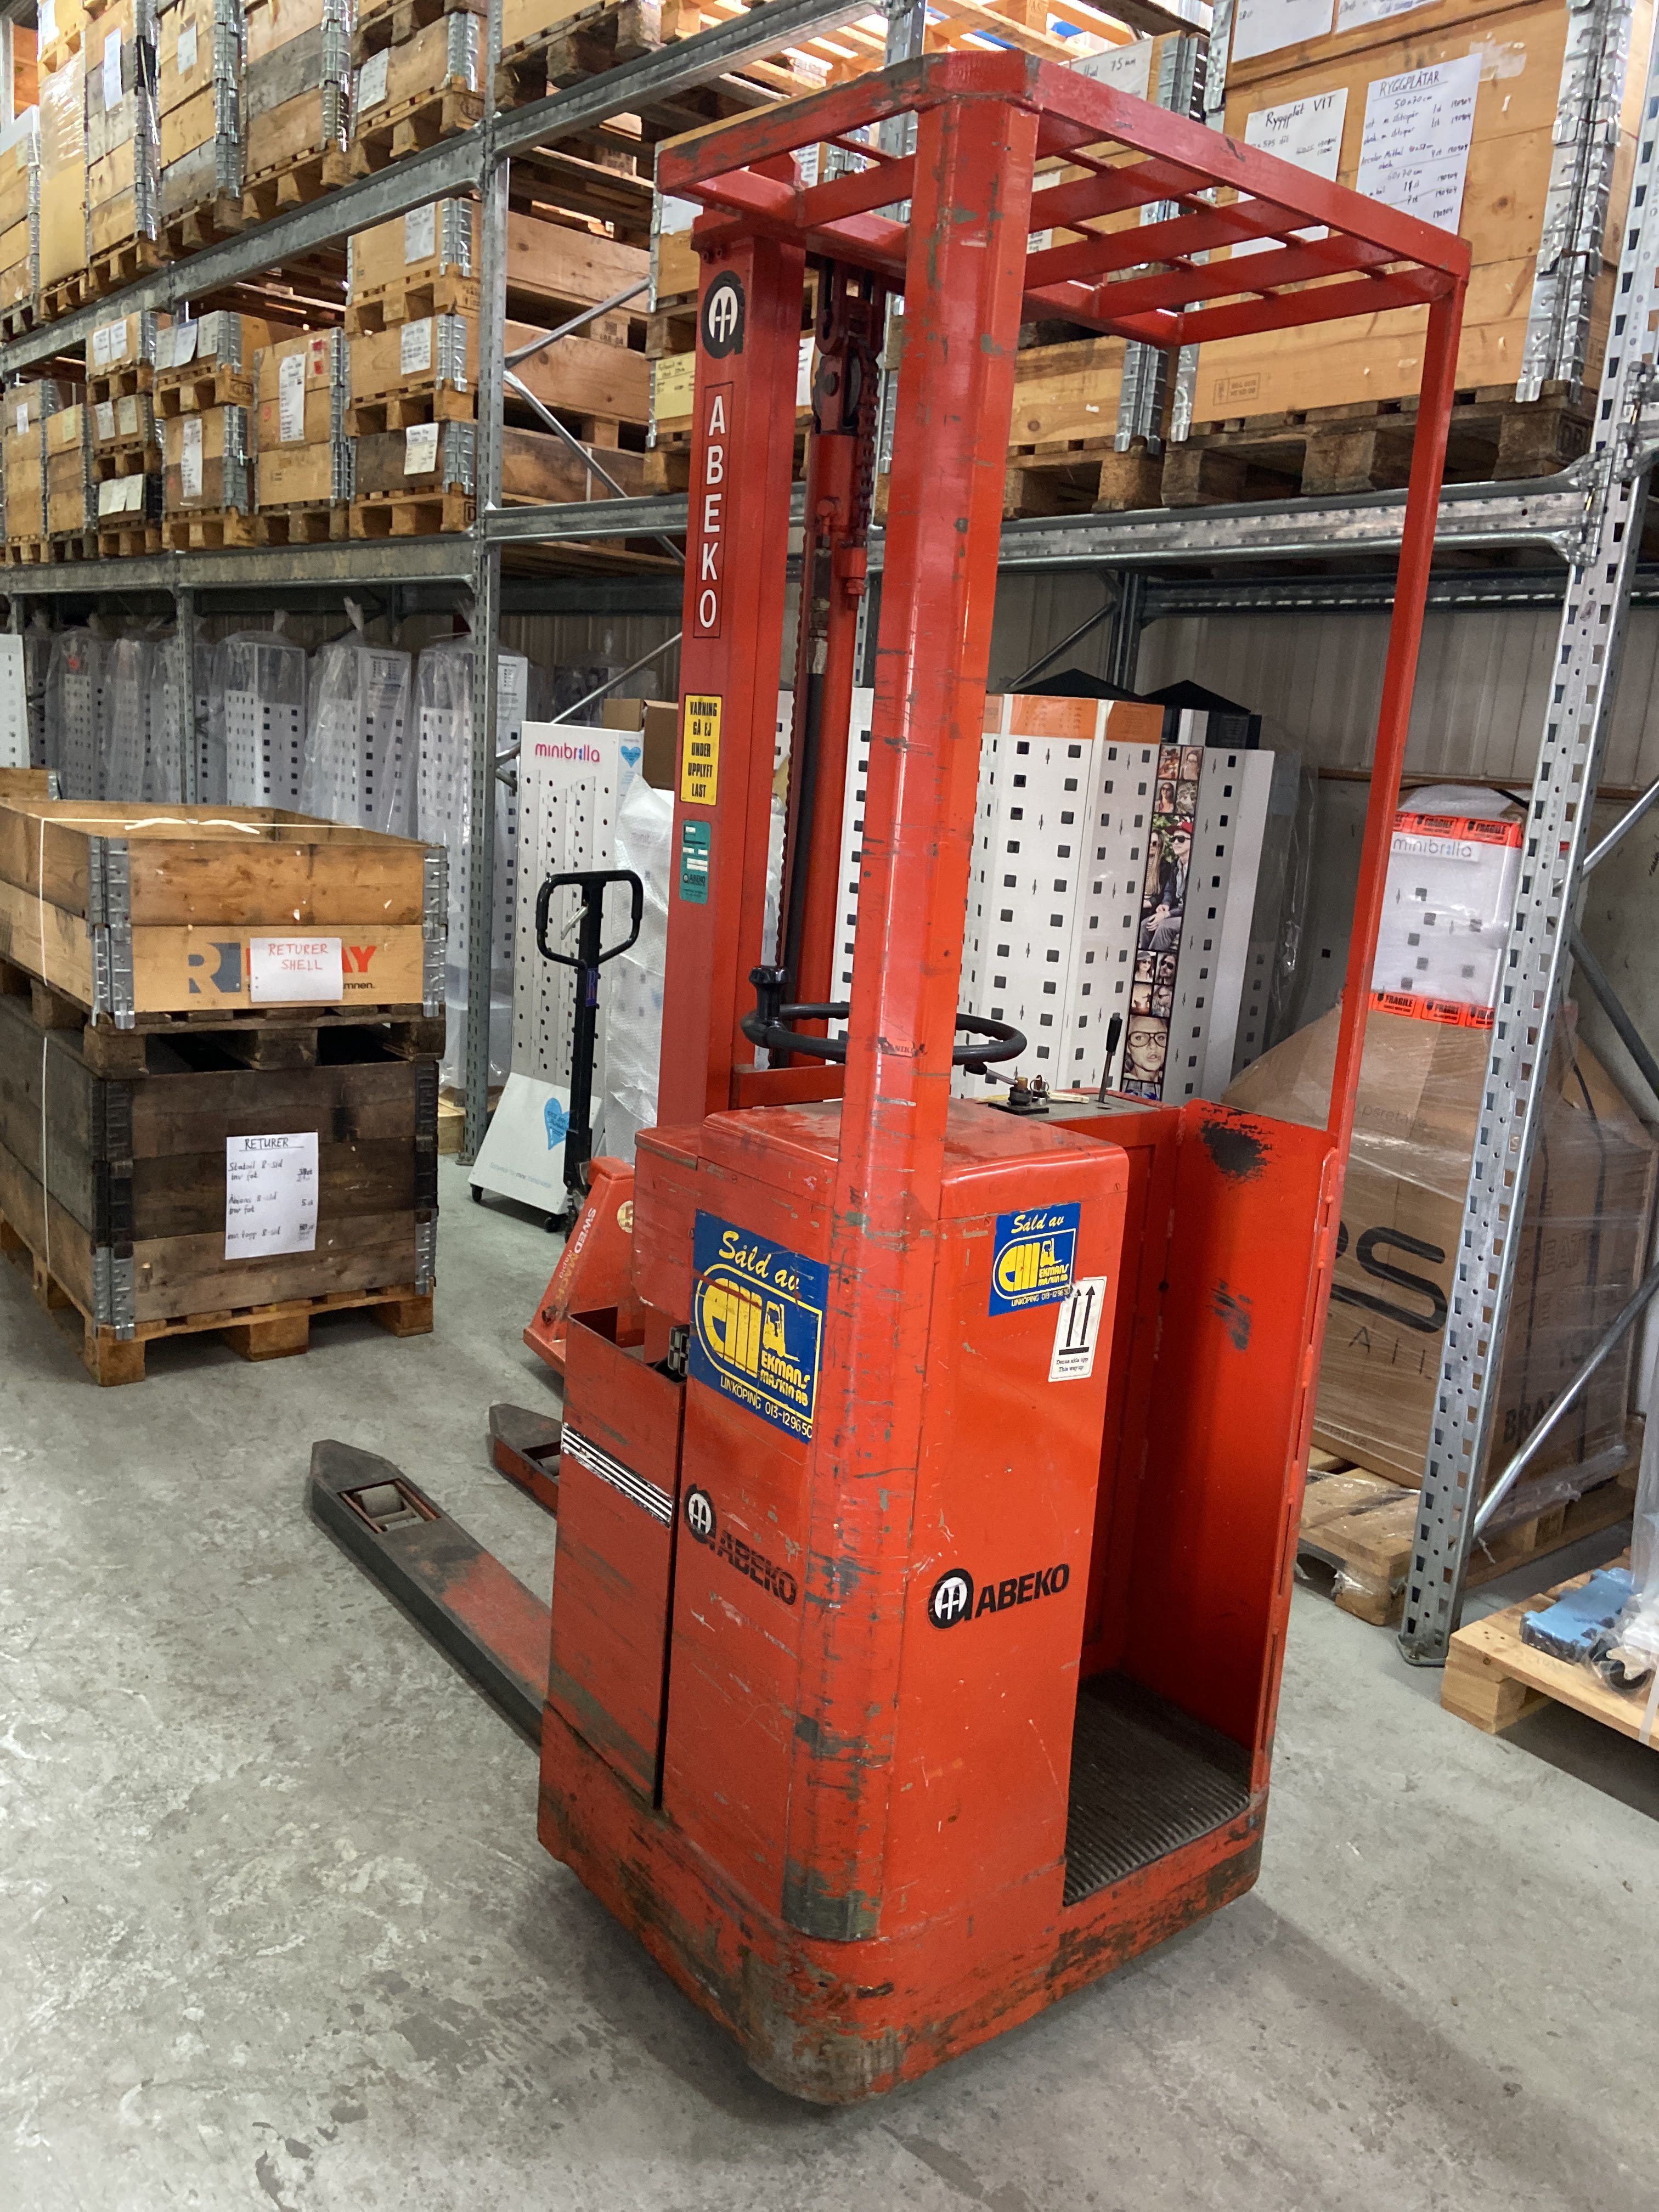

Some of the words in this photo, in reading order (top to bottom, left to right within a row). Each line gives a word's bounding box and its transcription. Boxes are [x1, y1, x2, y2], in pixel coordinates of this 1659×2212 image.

[1379, 70, 1440, 97] RYGGPLÅTAR
[1314, 94, 1335, 111] VIT
[699, 395, 726, 629] ABEKO
[690, 701, 717, 716] VARNING
[693, 719, 701, 736] GÅ
[704, 722, 712, 736] EJ
[691, 742, 711, 757] UNDER
[687, 762, 713, 778] UPPLYFT
[692, 783, 707, 798] LAST
[268, 943, 329, 956] RETURER
[281, 959, 323, 970] SHELL
[1385, 994, 1413, 1007] FRAGILE
[245, 1137, 289, 1150] RETURER
[1011, 1213, 1047, 1234] Såld
[1049, 1216, 1064, 1226] av
[719, 1231, 771, 1279] Såld
[775, 1268, 799, 1291] av
[1039, 1263, 1069, 1279] EKMANS
[1038, 1276, 1060, 1286] MASKIN
[761, 1350, 810, 1390] EKMANS
[720, 1375, 761, 1410] LINKÖPING
[760, 1369, 794, 1400] MASKIN
[795, 1389, 808, 1406] AB
[717, 1530, 797, 1605] ABEKO
[975, 1564, 1069, 1618] ABEKO
